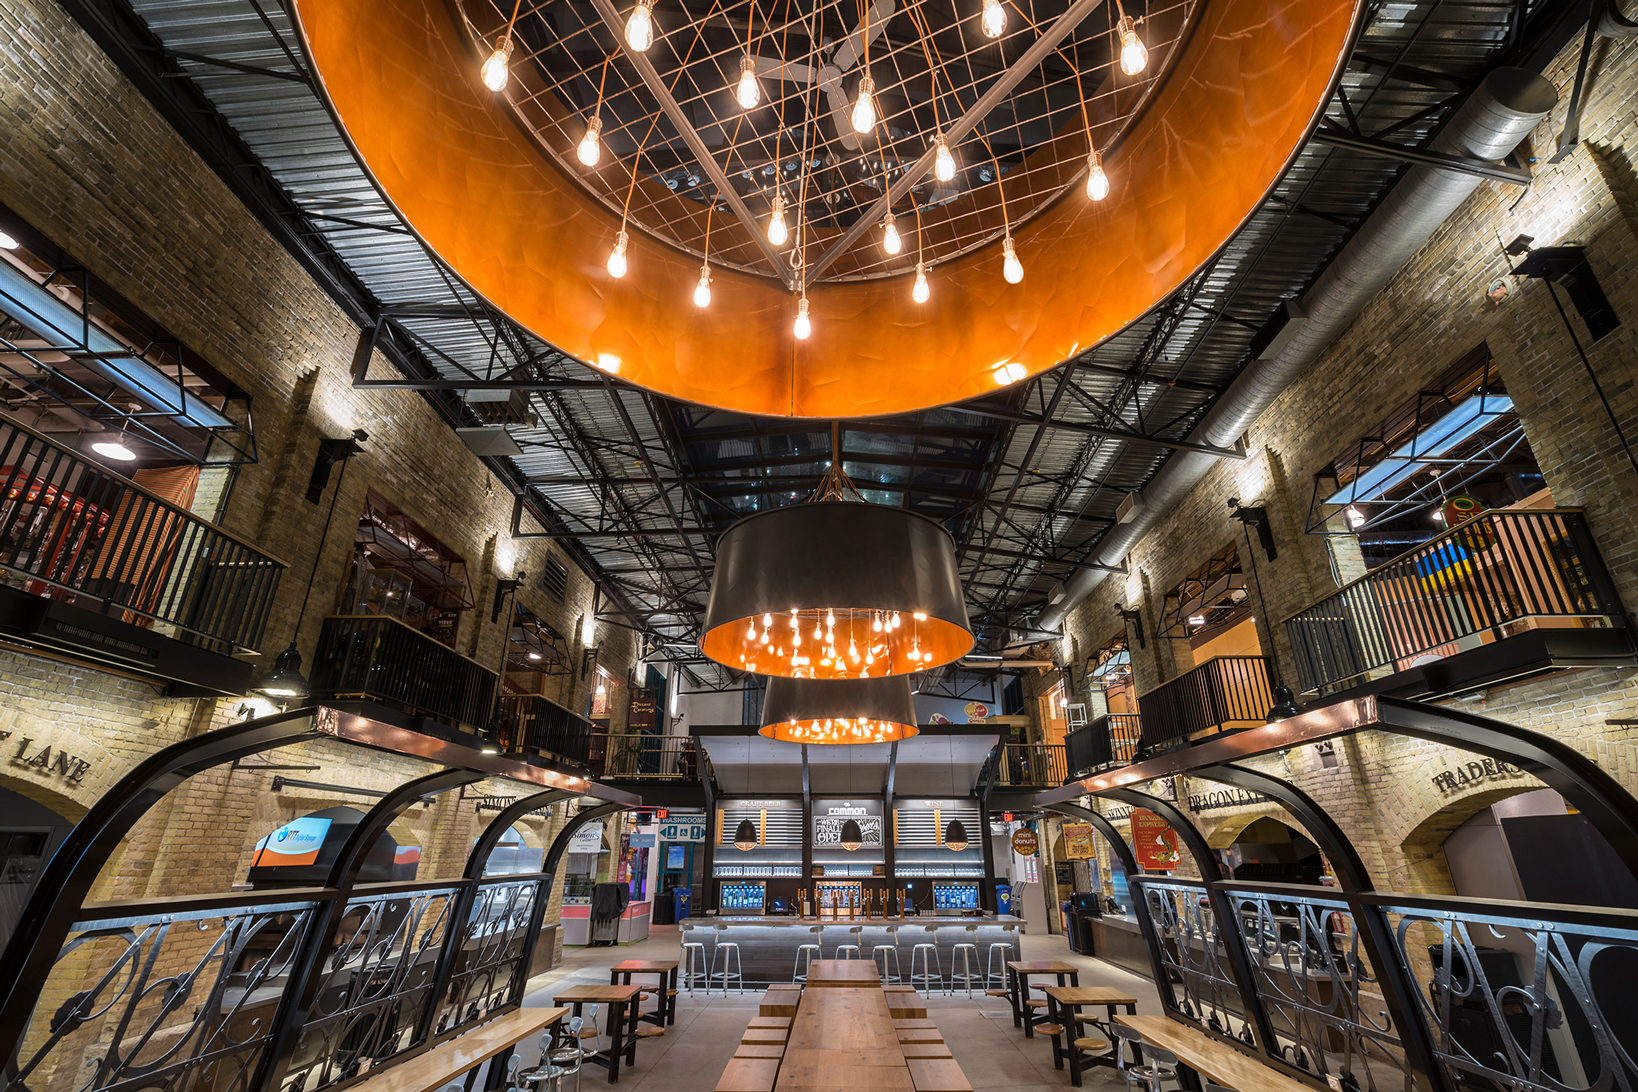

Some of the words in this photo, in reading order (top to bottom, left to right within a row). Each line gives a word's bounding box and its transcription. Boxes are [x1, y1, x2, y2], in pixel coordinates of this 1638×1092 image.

[12, 737, 91, 782] LANE
[740, 800, 763, 808] CRAFT
[764, 800, 782, 808] BEER
[924, 800, 944, 808] WINE
[1188, 790, 1235, 810] DRAGON
[828, 807, 866, 815] common
